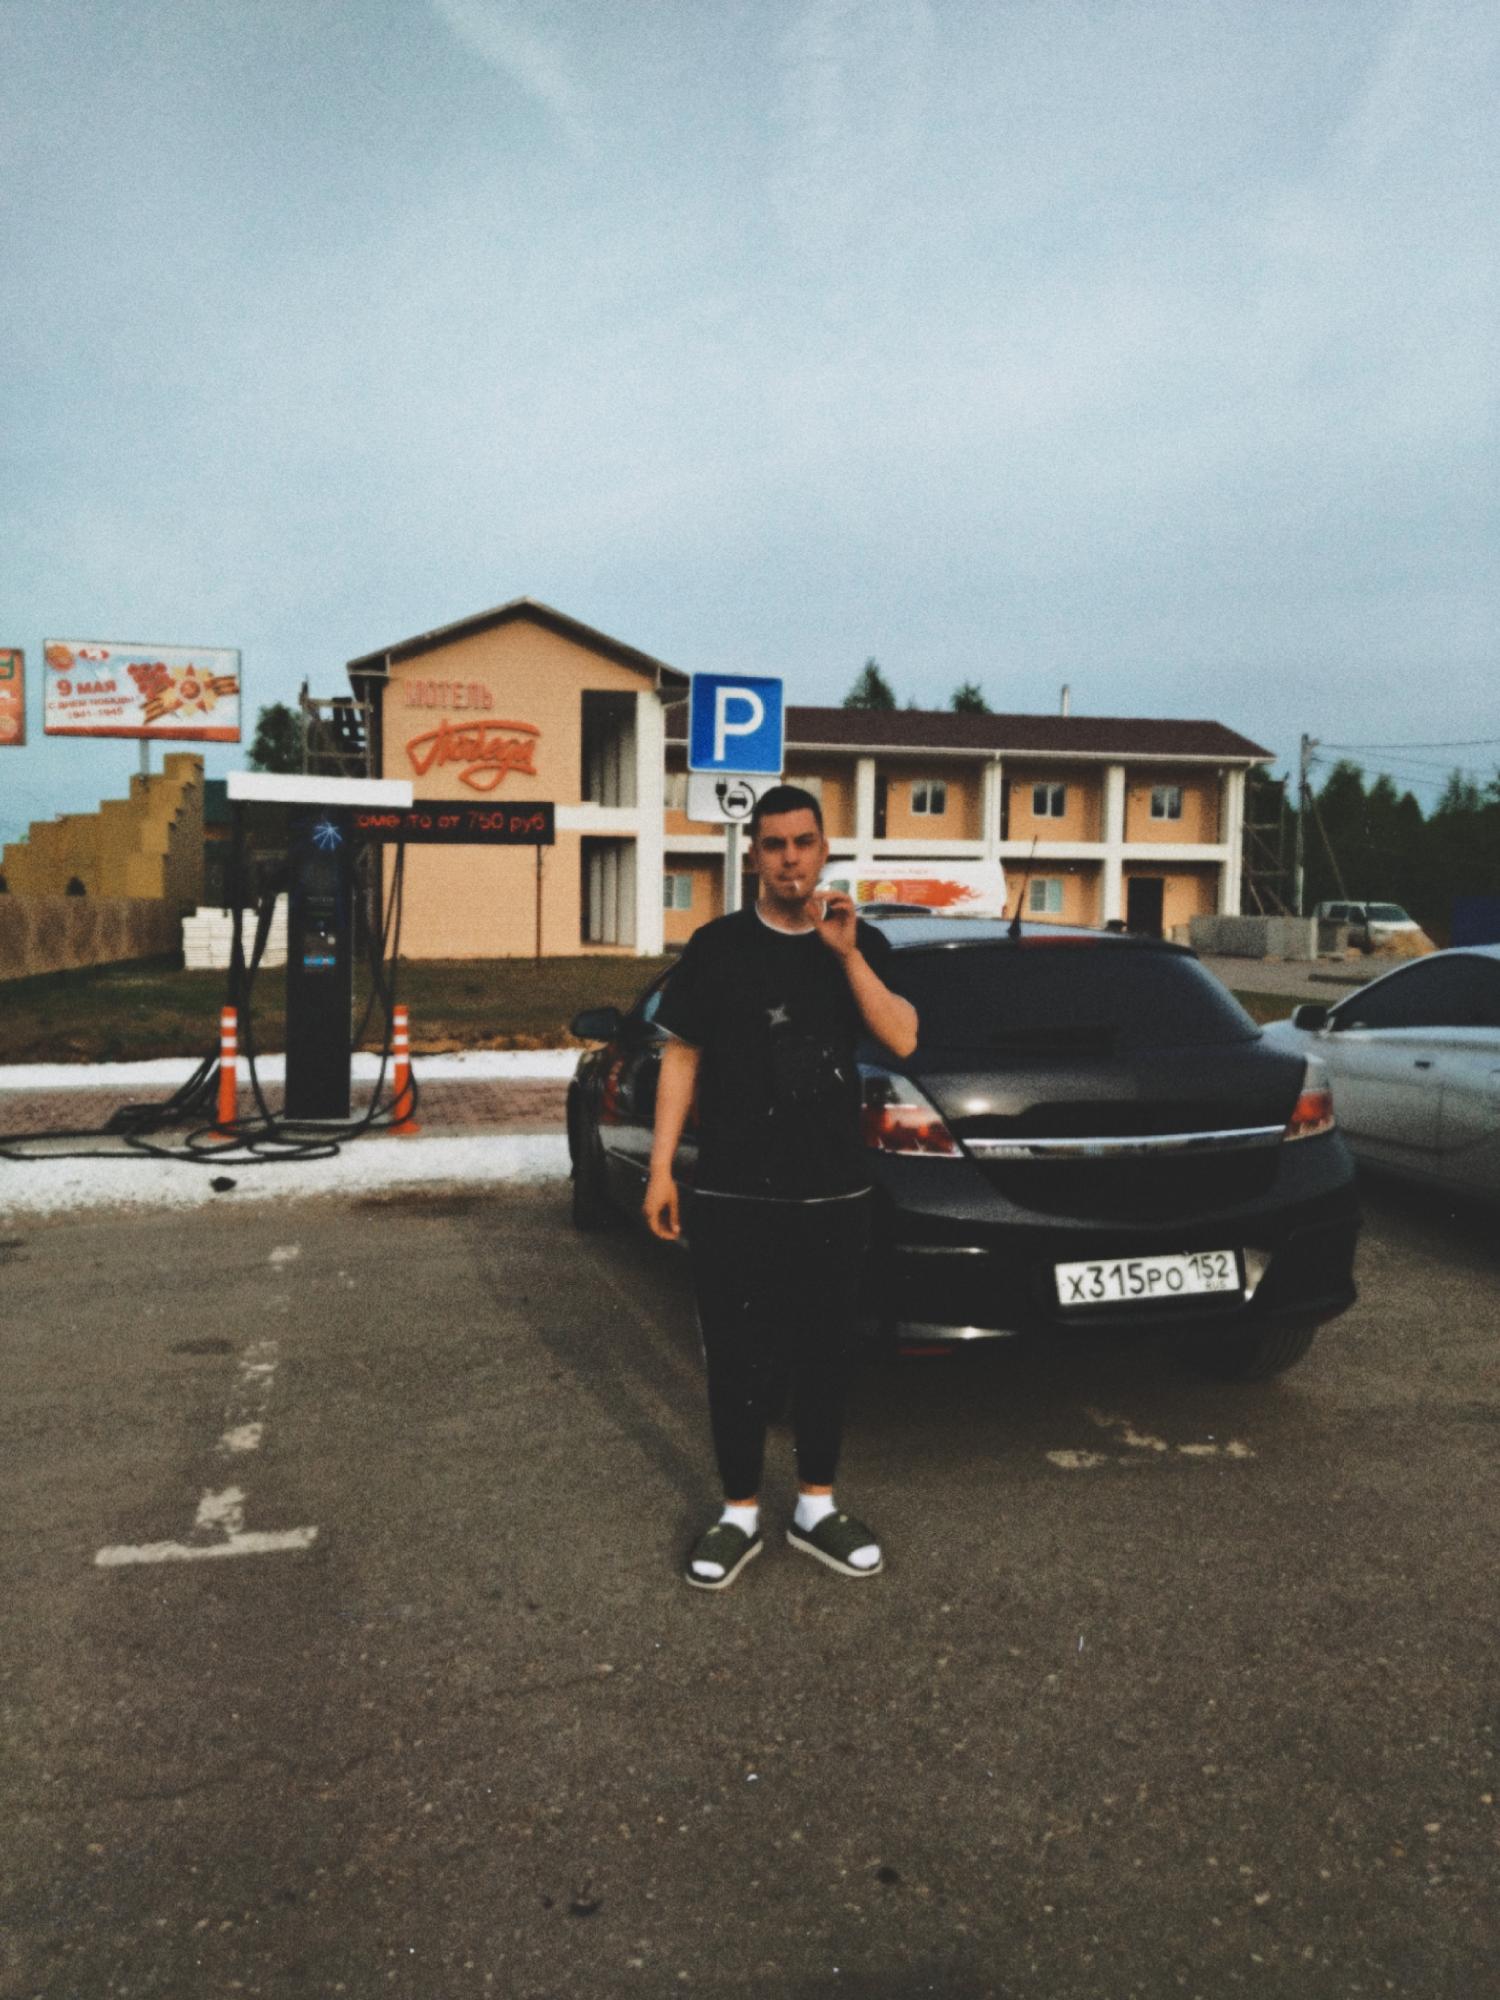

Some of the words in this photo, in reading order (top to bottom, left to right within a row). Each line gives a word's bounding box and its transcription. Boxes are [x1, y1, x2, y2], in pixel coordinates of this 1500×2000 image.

[57, 680, 72, 696] 9
[77, 680, 116, 694] МАЯ
[713, 686, 764, 761] P
[509, 812, 546, 832] руб
[1067, 1262, 1184, 1300] Х315РО
[1188, 1254, 1230, 1280] 152
[1205, 1281, 1226, 1290] RUS
